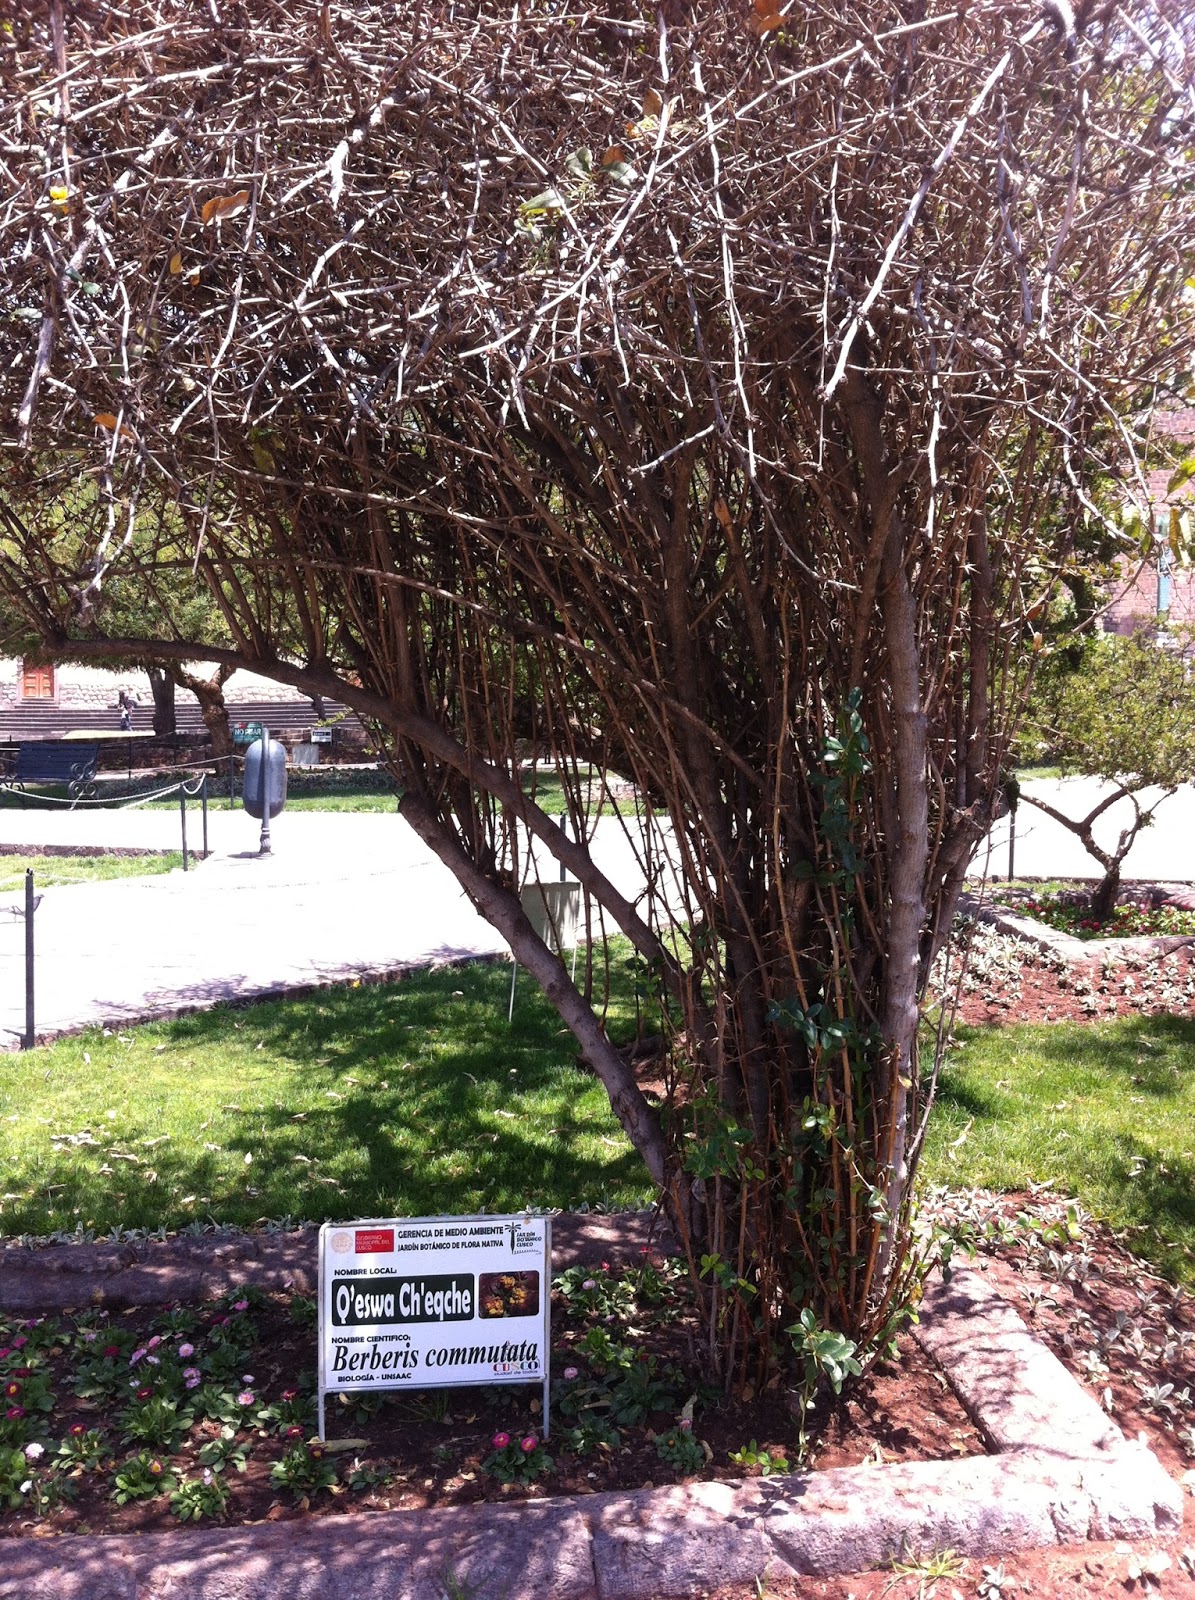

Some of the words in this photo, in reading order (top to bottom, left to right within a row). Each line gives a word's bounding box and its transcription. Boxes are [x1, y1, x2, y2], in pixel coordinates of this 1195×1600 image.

[398, 1230, 432, 1239] GERENCIA
[434, 1229, 444, 1237] DE
[445, 1228, 468, 1236] MEDIO
[469, 1226, 504, 1236] AMBIENTE
[398, 1243, 419, 1252] JARDÍN
[420, 1241, 451, 1251] BOTÁNICO
[461, 1241, 481, 1249] FLORA
[482, 1240, 504, 1248] NATIVA
[334, 1268, 367, 1276] NOMBRE
[369, 1267, 397, 1275] LOCAL:
[336, 1284, 395, 1324] Q'eswa
[399, 1280, 471, 1321] Ch'eqche
[331, 1336, 365, 1344] NOMBRE
[366, 1334, 411, 1343] CIENTIFICO:
[331, 1342, 419, 1372] Berberis
[425, 1339, 538, 1367] commutata
[493, 1361, 539, 1372] CUSCO
[337, 1373, 375, 1382] BIOLOGÍA
[381, 1372, 412, 1380] UNSAAC
